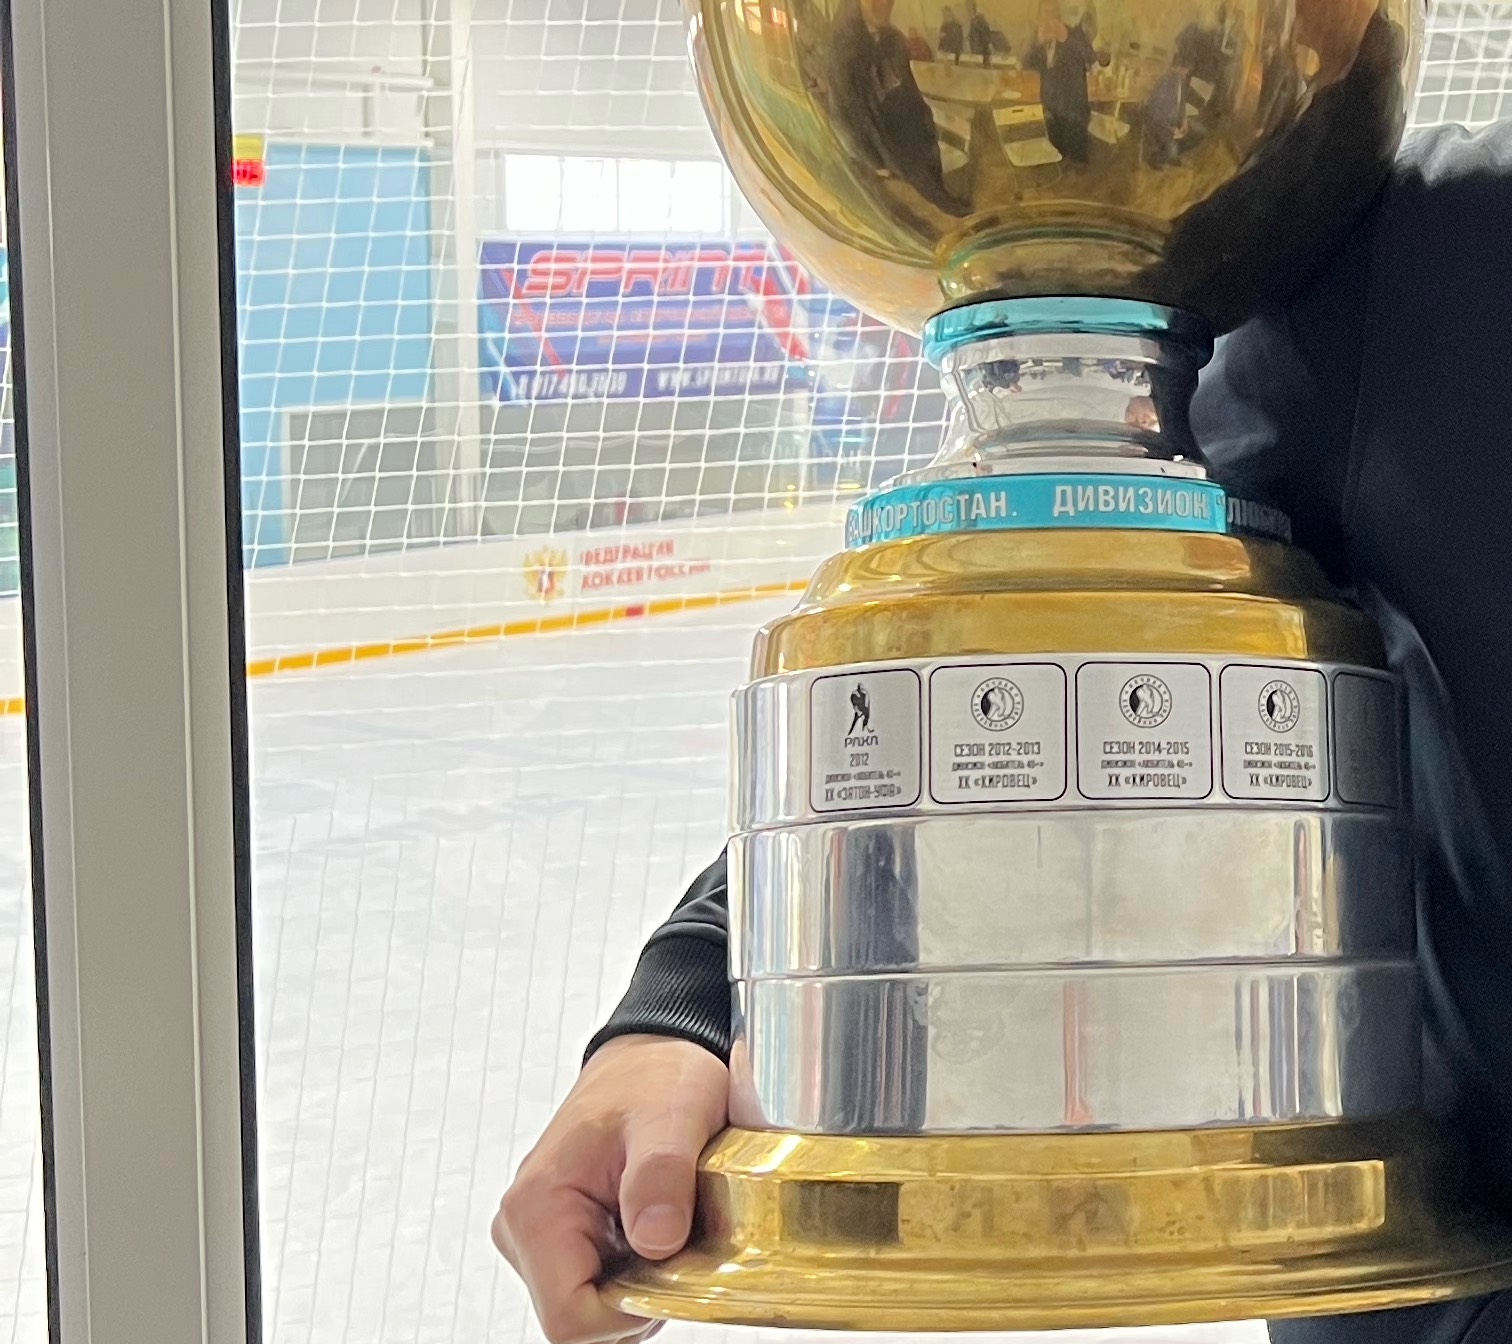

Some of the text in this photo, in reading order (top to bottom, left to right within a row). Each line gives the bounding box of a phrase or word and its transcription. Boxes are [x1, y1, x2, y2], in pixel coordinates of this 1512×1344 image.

[1053, 485, 1209, 519] ДИВИЗИОН
[954, 741, 1041, 757] СЕЗОН 2012-2013
[1103, 740, 1190, 755] СЕЗОН 2014-2015
[1244, 741, 1314, 758] СЕЗОН 2015-2016
[849, 752, 870, 767] 2012
[974, 773, 1038, 789] «КИРОВЕЦ»
[1124, 772, 1188, 789] «КИРОВЕЦ»
[1263, 773, 1313, 790] «КИРОВЕЦ»
